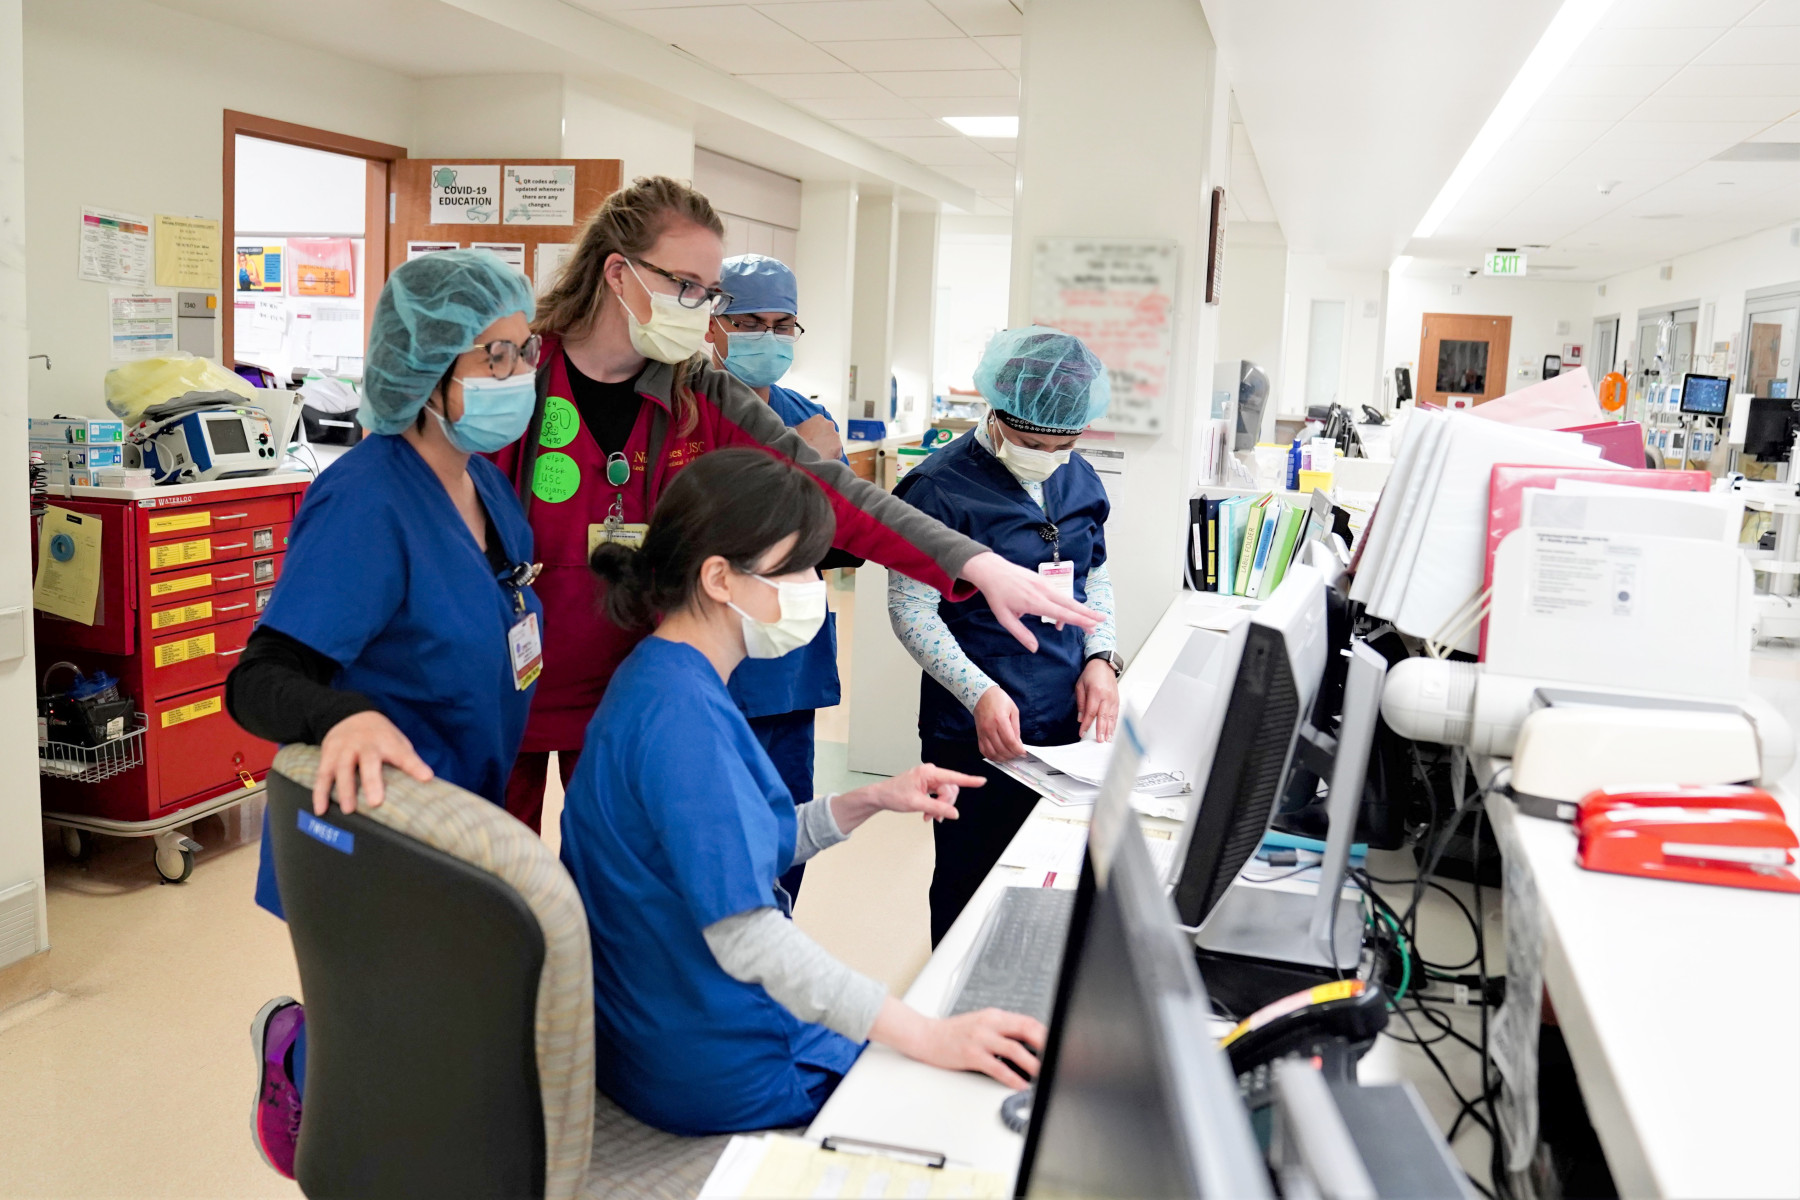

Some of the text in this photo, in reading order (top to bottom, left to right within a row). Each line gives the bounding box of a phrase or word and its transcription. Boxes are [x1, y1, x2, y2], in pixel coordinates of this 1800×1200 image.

[444, 186, 487, 195] COVID-19
[439, 197, 492, 206] EDUCATION
[1493, 255, 1520, 273] EXIT
[114, 455, 120, 463] M
[537, 482, 567, 496] Trojans
[158, 496, 192, 506] WATERLOO
[1241, 528, 1255, 574] LABEL FOLDER
